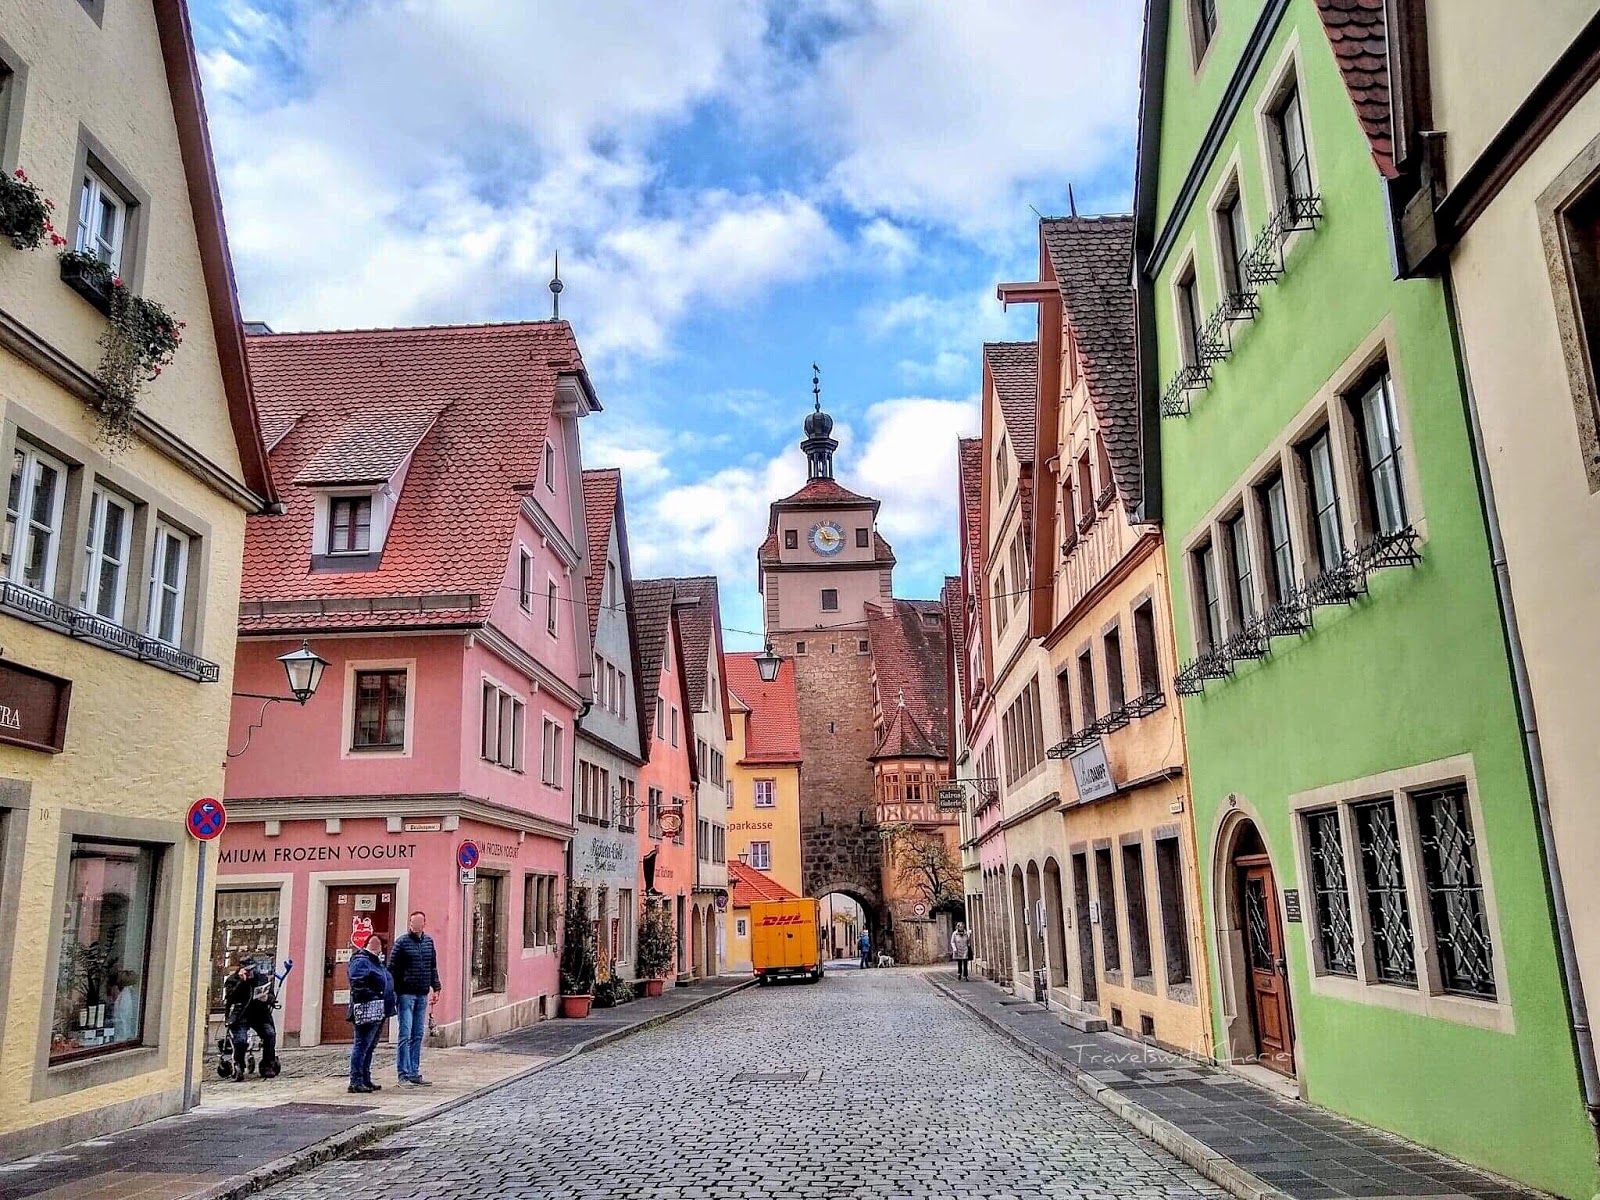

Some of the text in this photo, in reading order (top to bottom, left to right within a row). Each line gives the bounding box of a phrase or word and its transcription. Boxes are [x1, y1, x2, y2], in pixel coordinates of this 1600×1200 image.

[274, 846, 340, 862] FROZEN
[347, 845, 417, 860] YOGURT
[763, 915, 804, 926] DHL
